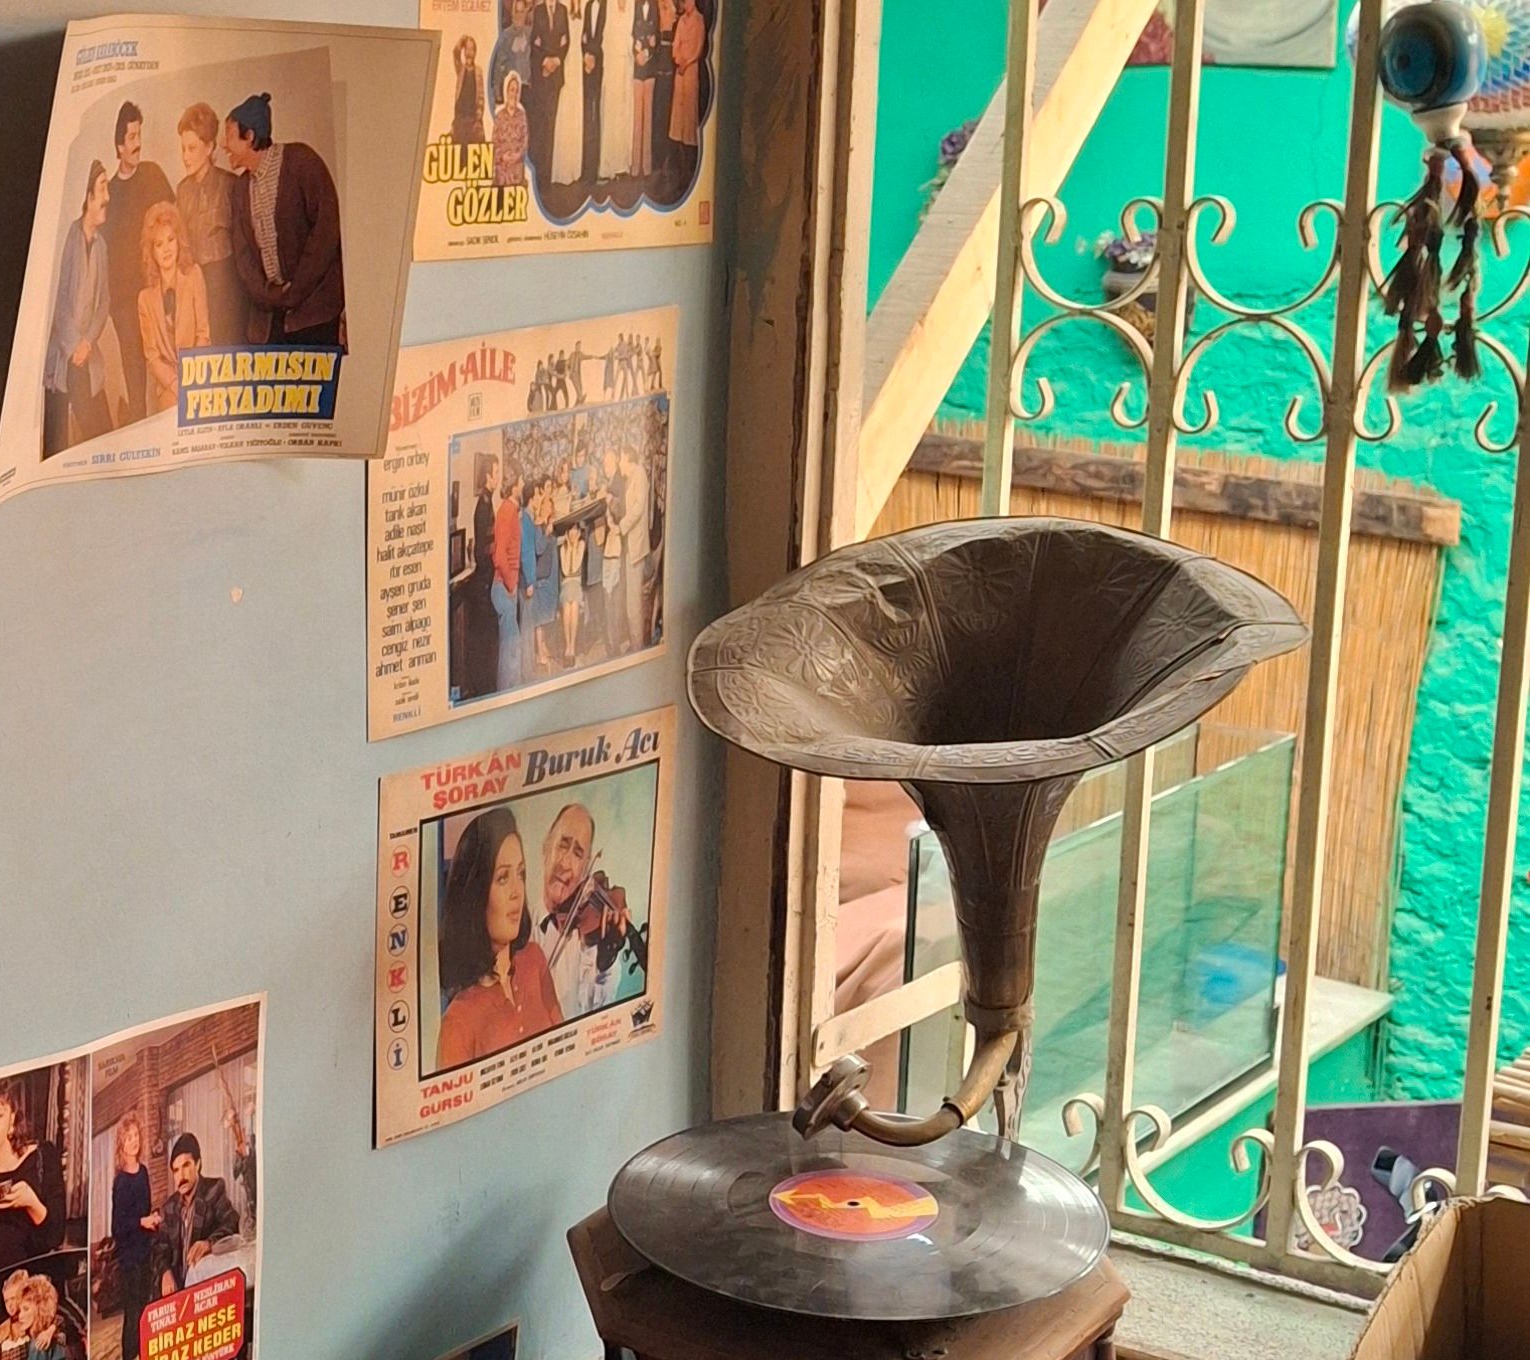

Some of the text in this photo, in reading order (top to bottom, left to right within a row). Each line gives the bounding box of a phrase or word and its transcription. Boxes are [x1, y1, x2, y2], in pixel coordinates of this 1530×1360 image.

[422, 135, 496, 183] GÜLEN
[446, 181, 530, 226] GÖZLER
[181, 351, 338, 387] DUYARMISIN
[459, 341, 517, 386] AİLE
[186, 384, 323, 421] FERYADIMI
[406, 504, 428, 519] akan
[402, 560, 423, 577] esen
[407, 576, 432, 595] gruda
[411, 597, 427, 614] şen
[381, 637, 409, 658] cengiz
[375, 659, 403, 678] ahmet
[521, 734, 612, 788] Buruk
[614, 726, 661, 765] Acı
[432, 775, 510, 811] ŞORAY
[420, 1072, 474, 1101] TANJU
[147, 1301, 177, 1323] FARUK
[193, 1296, 219, 1315] ACAR
[148, 1303, 237, 1357] BİRAZ NEŞE
[192, 1322, 243, 1358] KEDER
